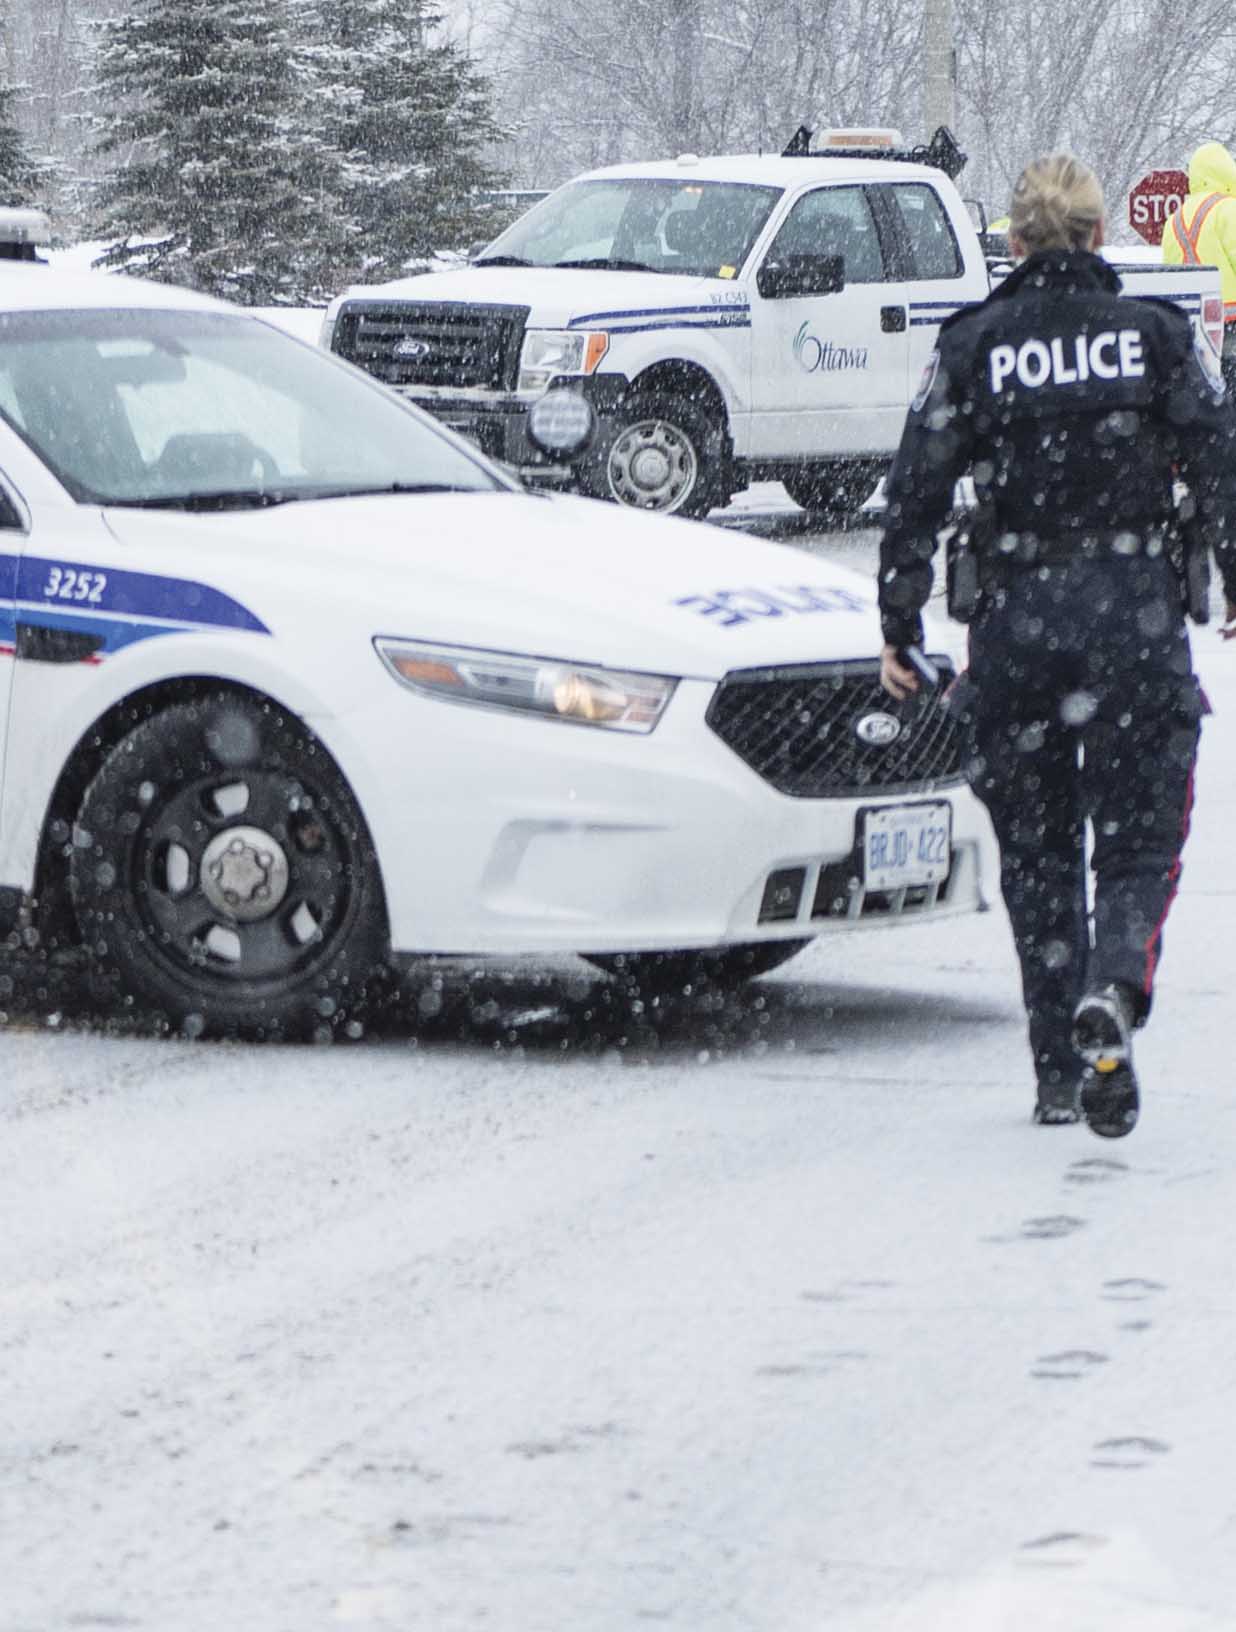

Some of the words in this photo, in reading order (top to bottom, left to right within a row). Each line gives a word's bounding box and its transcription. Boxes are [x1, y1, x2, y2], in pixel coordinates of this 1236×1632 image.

[1133, 194, 1182, 224] STO
[794, 335, 869, 374] Ottawa
[989, 329, 1146, 394] POLICE
[43, 566, 108, 603] 3252
